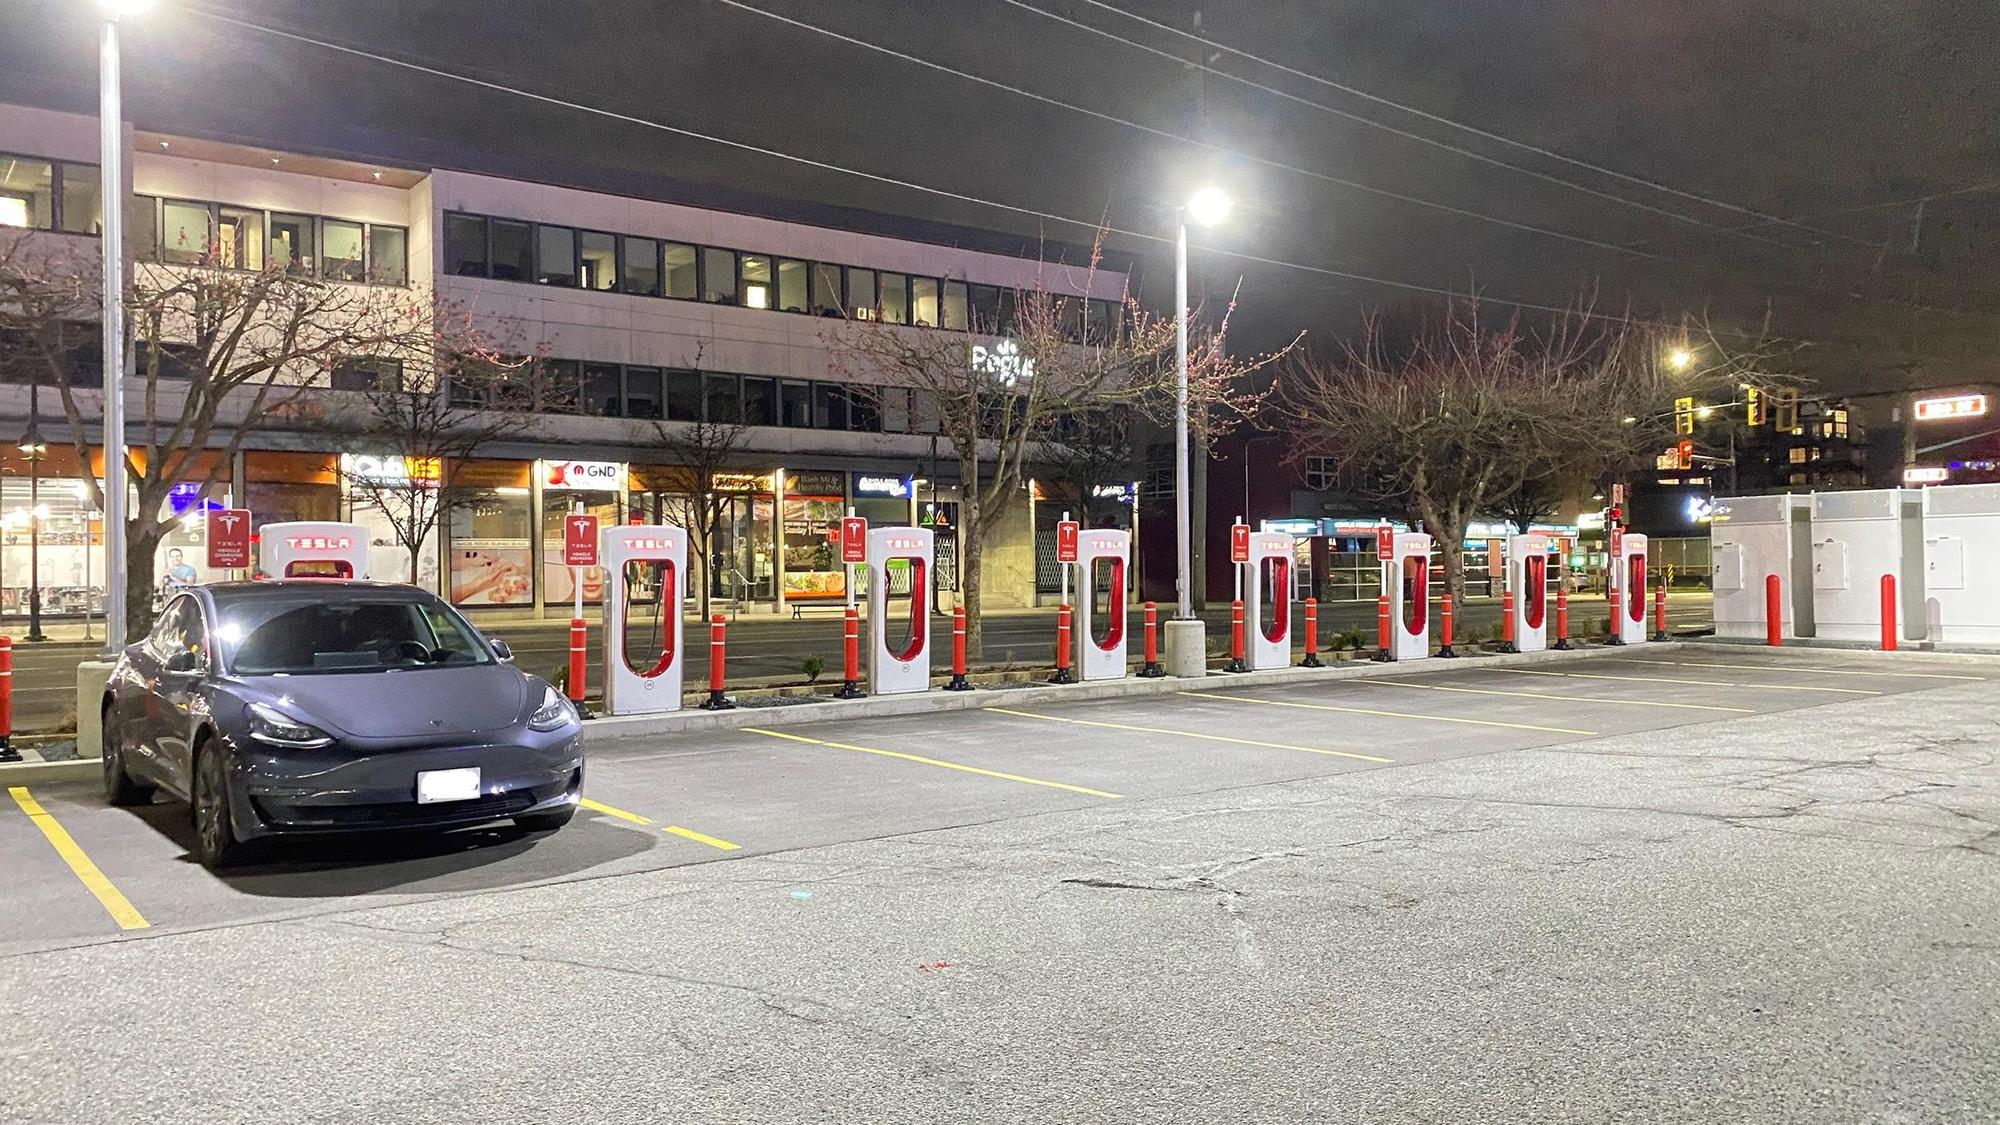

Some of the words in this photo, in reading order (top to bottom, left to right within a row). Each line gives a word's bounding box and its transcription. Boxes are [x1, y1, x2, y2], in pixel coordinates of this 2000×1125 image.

[587, 465, 616, 478] GND
[286, 538, 351, 549] TESLA
[623, 539, 673, 549] TESLA
[885, 539, 925, 549] TESLA
[1091, 540, 1124, 549] TESLA
[1261, 542, 1289, 550] TESLA
